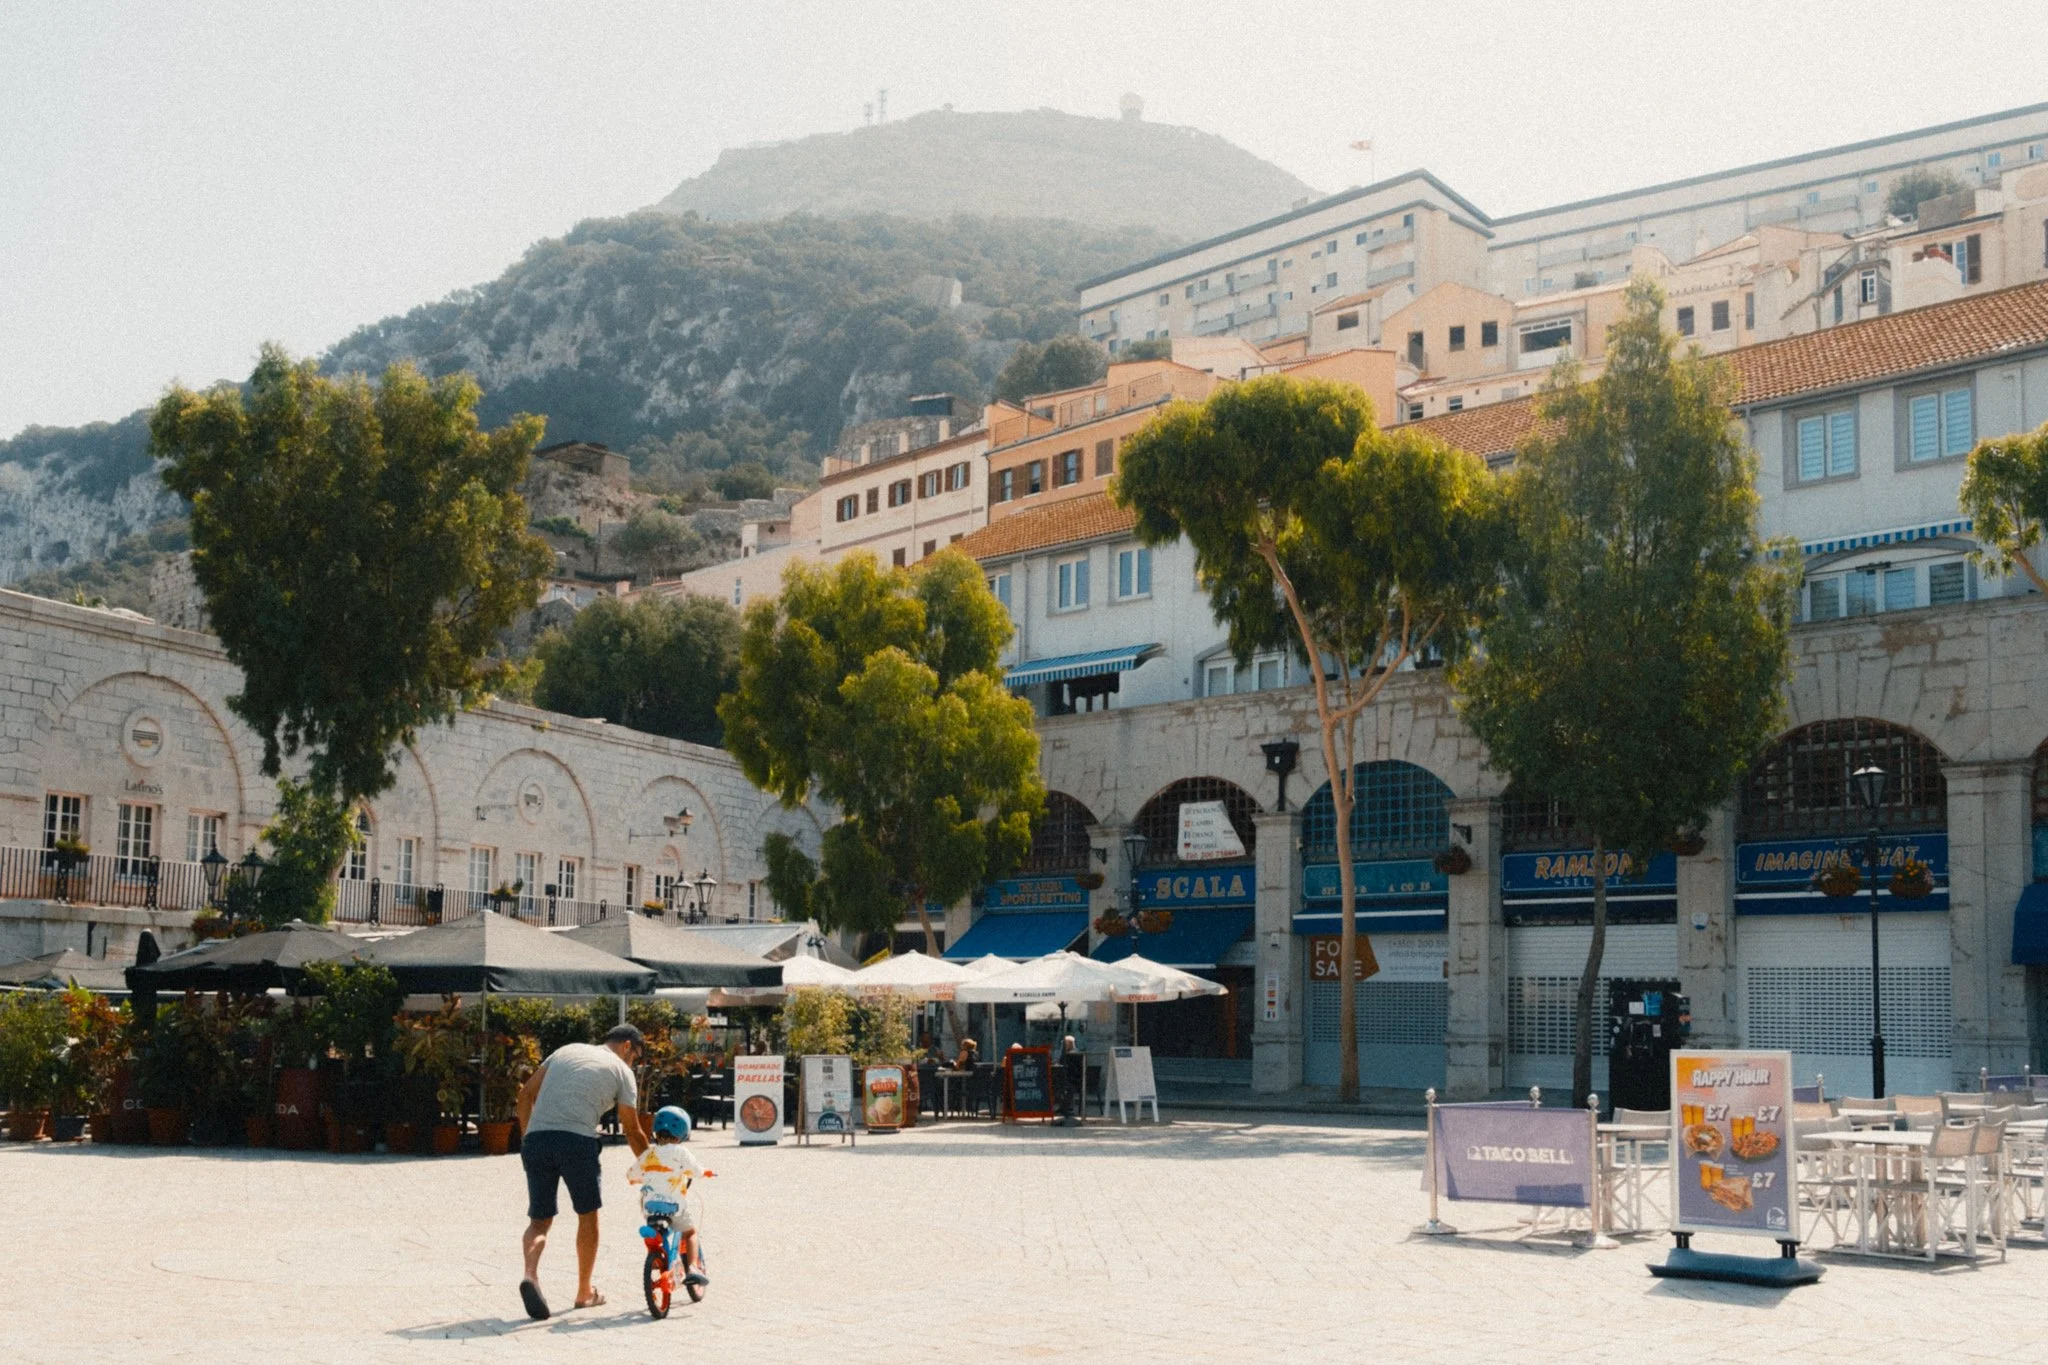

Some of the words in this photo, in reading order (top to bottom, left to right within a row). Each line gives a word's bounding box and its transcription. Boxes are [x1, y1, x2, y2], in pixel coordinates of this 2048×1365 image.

[124, 778, 164, 795] Latino's
[1534, 853, 1648, 879] RAMSON
[1755, 849, 1851, 871] IMAGINE
[1156, 874, 1246, 899] SCALA
[1000, 894, 1037, 906] SPORTS
[1039, 891, 1081, 904] BETTING
[1315, 940, 1342, 957] FO
[1315, 960, 1362, 976] SAE
[736, 1074, 782, 1083] PAELLAS
[1692, 1069, 1735, 1088] HAPPY
[1735, 1068, 1771, 1086] HOUR
[1706, 1103, 1729, 1121] £7
[1757, 1105, 1781, 1122] £7
[1481, 1146, 1526, 1162] TACO
[1527, 1147, 1574, 1165] BELL
[1752, 1171, 1775, 1188] £7
